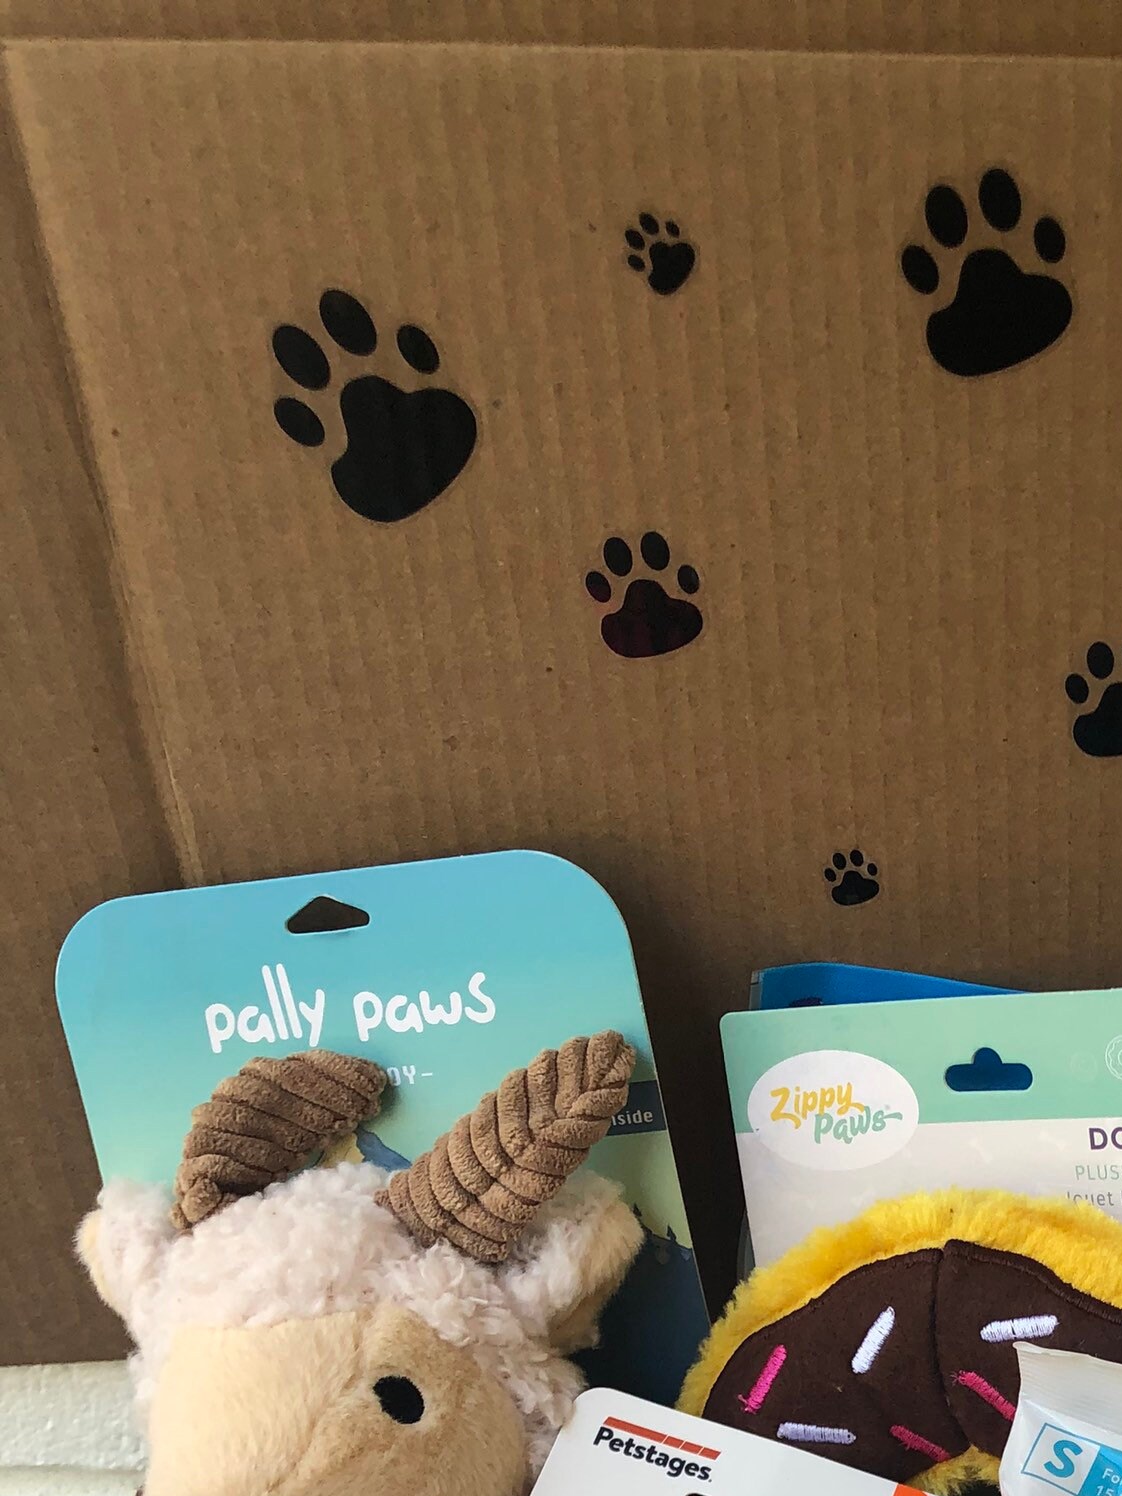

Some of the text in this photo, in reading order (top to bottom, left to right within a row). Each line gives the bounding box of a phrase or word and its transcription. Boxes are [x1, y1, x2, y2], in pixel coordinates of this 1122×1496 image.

[205, 963, 496, 1053] pally paws
[770, 1082, 865, 1130] Zippy
[814, 1105, 903, 1144] Paws
[593, 1426, 712, 1482] Petstages
[1043, 1439, 1083, 1478] S
